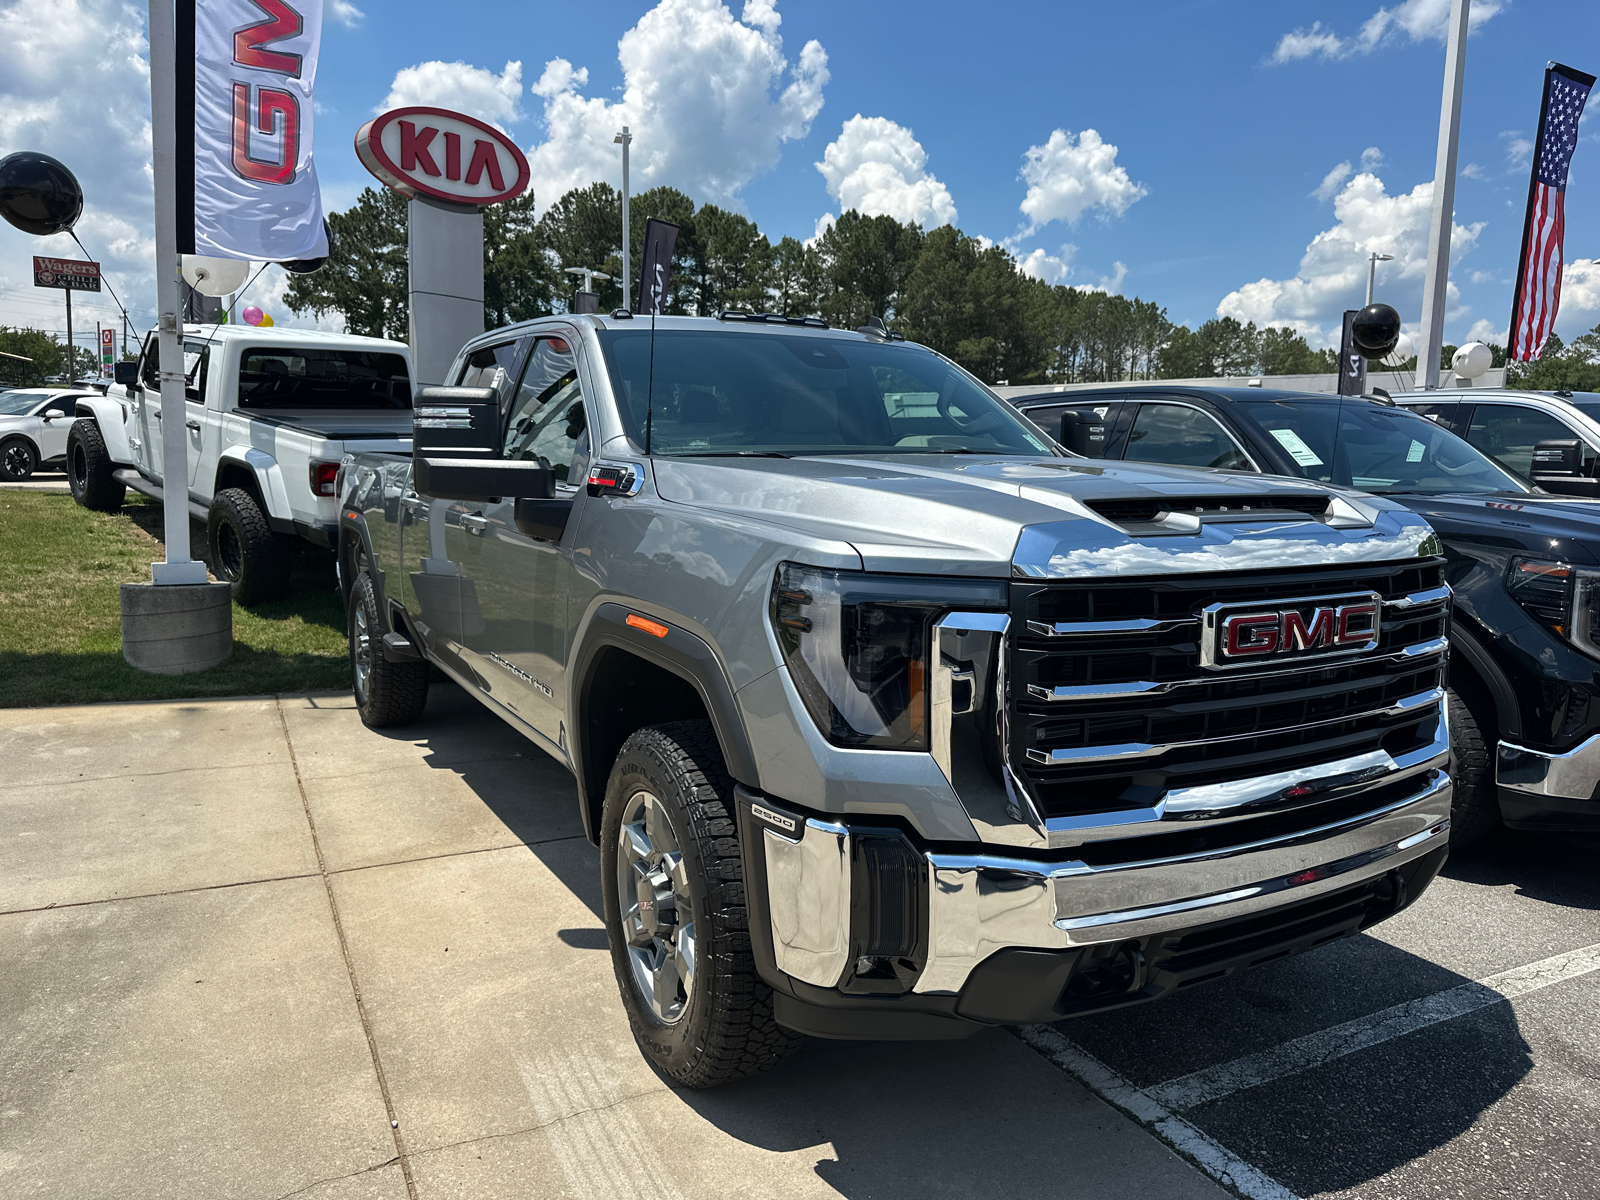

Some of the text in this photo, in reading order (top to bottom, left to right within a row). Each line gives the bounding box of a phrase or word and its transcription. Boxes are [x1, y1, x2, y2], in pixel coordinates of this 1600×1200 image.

[397, 119, 505, 192] KIA
[37, 257, 97, 275] Wagers
[57, 274, 97, 284] GRILL
[71, 281, 97, 289] BAR
[1220, 602, 1378, 657] GMC
[489, 651, 554, 698] SIERRA HD
[753, 806, 793, 828] 2500
